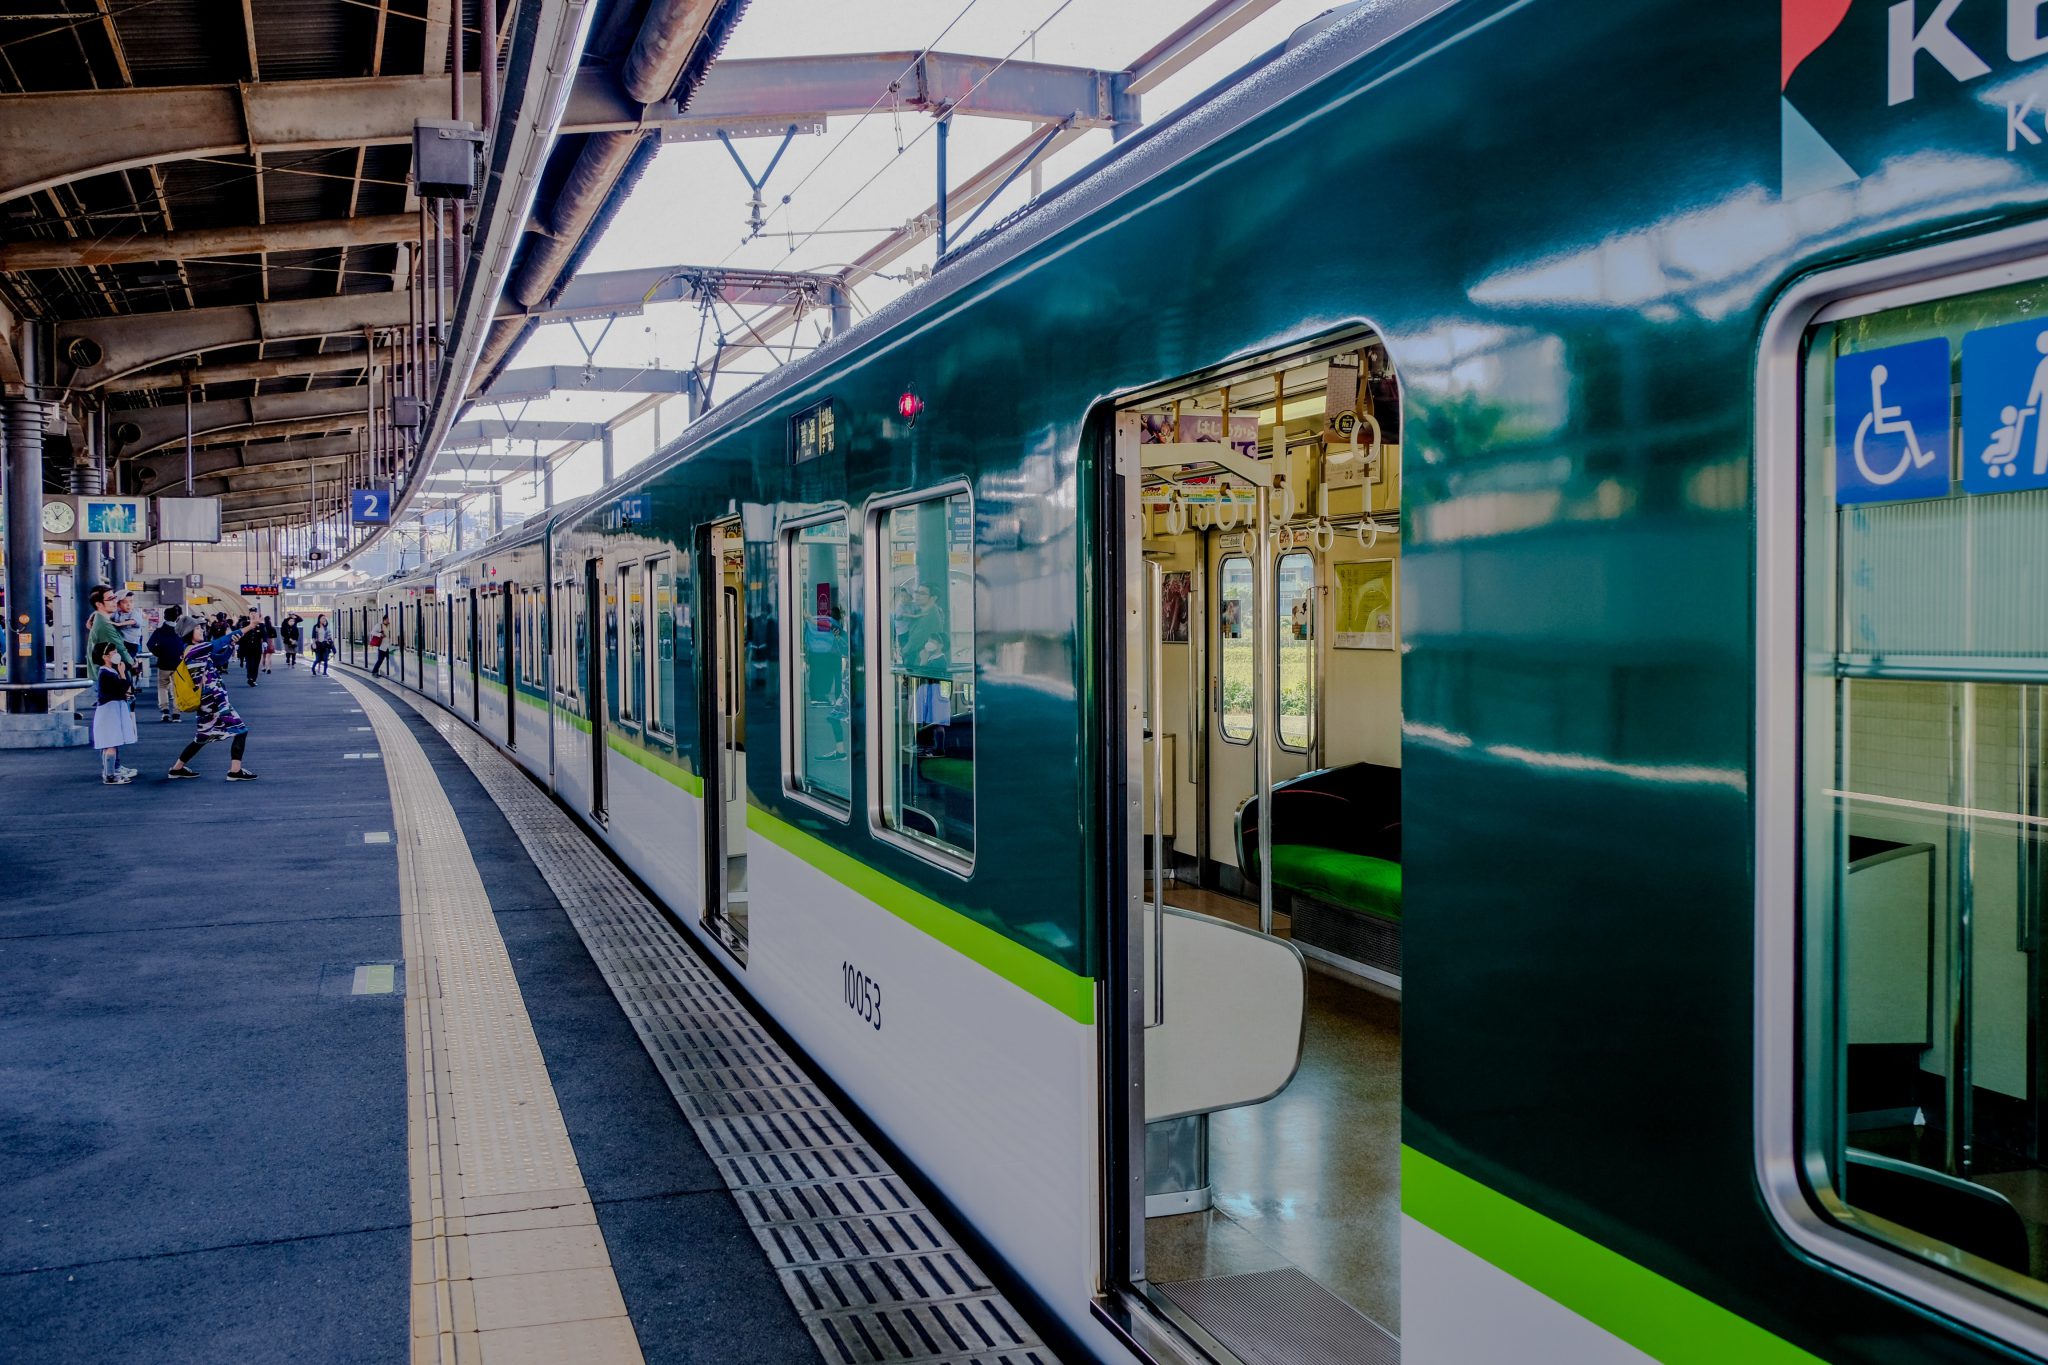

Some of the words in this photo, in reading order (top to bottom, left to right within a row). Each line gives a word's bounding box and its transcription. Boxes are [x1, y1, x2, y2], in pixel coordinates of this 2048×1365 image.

[363, 494, 379, 517] 2
[285, 578, 292, 587] 2
[842, 960, 882, 1031] 10053
